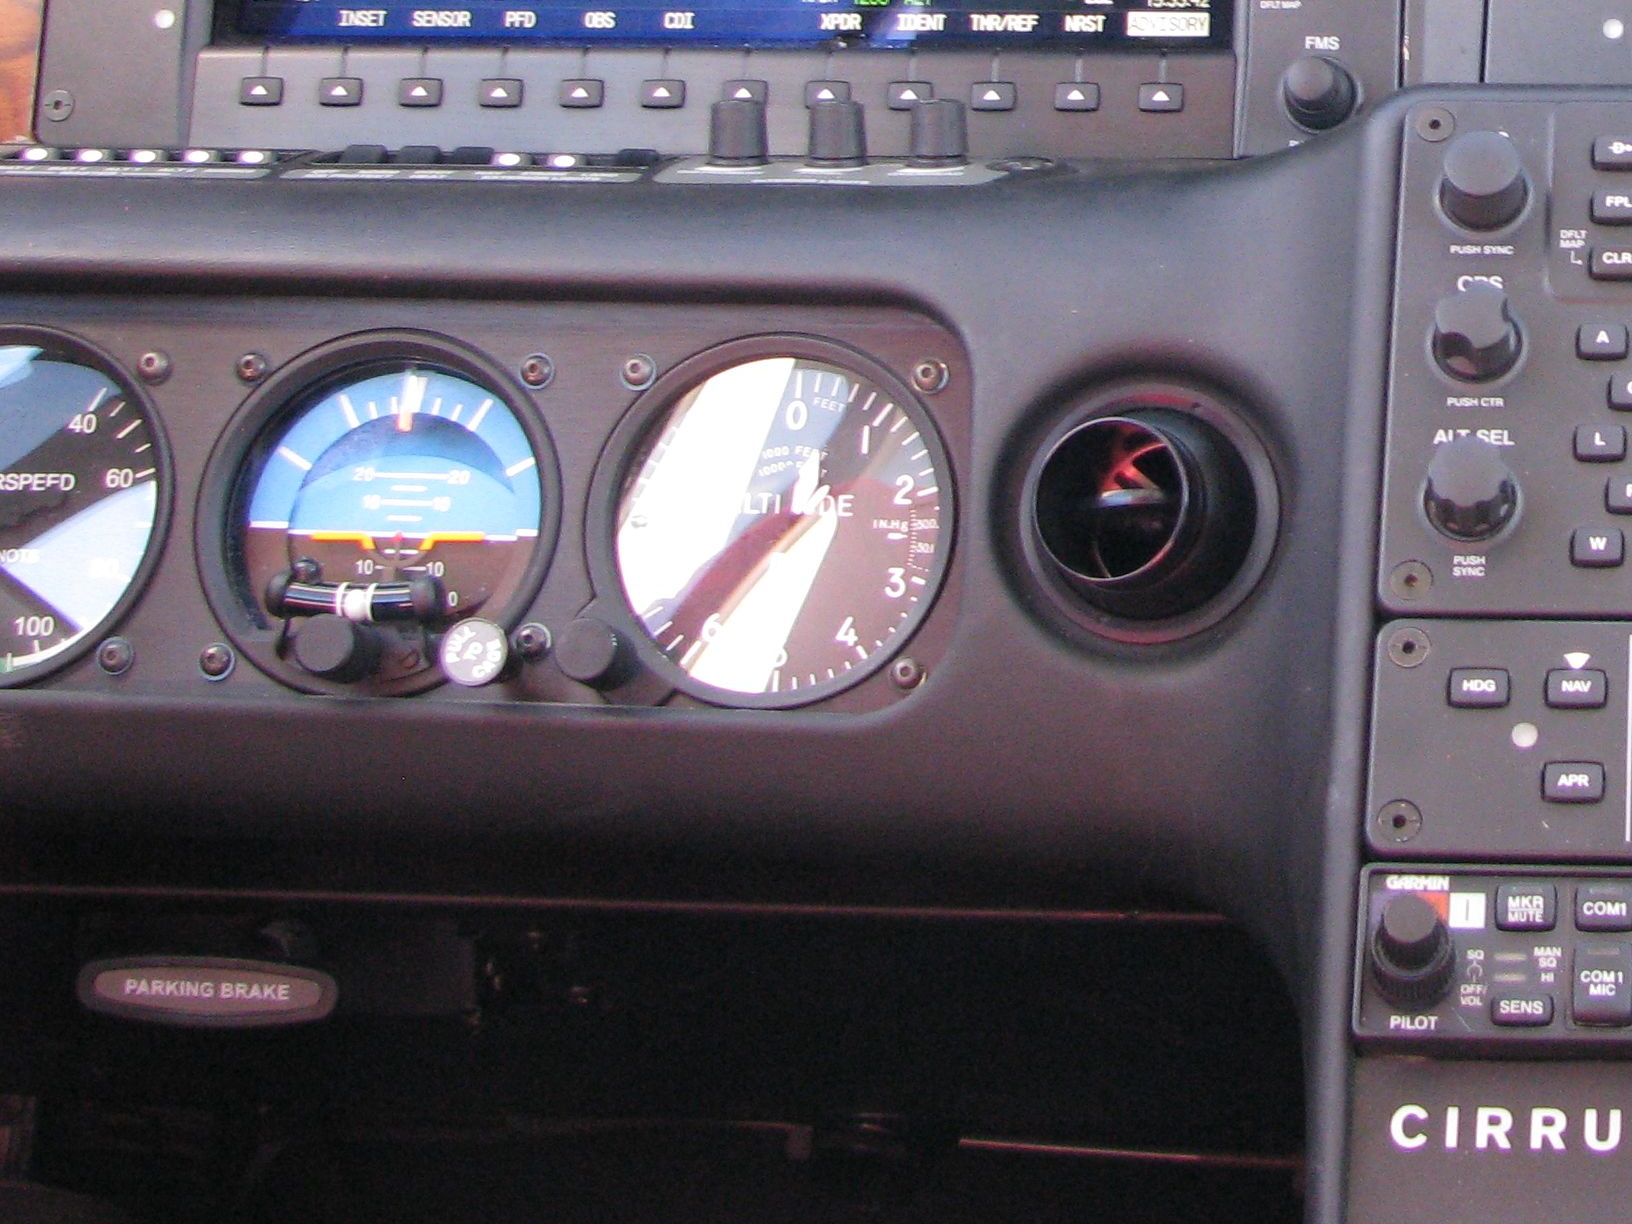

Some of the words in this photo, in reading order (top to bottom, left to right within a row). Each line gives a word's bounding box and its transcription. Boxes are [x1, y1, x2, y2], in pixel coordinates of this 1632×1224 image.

[339, 11, 386, 26] INSET
[413, 11, 471, 27] SENSOR
[506, 12, 535, 27] PFD
[665, 13, 694, 28] CDI
[1065, 15, 1105, 31] NRST
[1305, 37, 1339, 50] FMS
[1606, 196, 1632, 208] FPL
[1450, 245, 1480, 255] PUSH
[1483, 245, 1514, 255] SYNC
[1603, 252, 1632, 264] CLR
[786, 400, 807, 430] 0
[69, 414, 96, 433] 40
[106, 469, 133, 487] 60
[894, 475, 914, 504] 2
[885, 568, 905, 597] 3
[15, 617, 54, 635] 100
[836, 618, 857, 645] 4
[1463, 680, 1495, 692] HDG
[1562, 680, 1590, 692] NAV
[1558, 774, 1589, 786] APR
[1508, 896, 1543, 909] MKR
[1508, 910, 1543, 922] MUTE
[1583, 903, 1627, 916] COM1
[124, 979, 214, 998] PARKING
[221, 982, 290, 1000] BRAKE
[1589, 985, 1615, 995] MIC
[1500, 1000, 1543, 1013] SENS
[1390, 1016, 1437, 1030] PILOT
